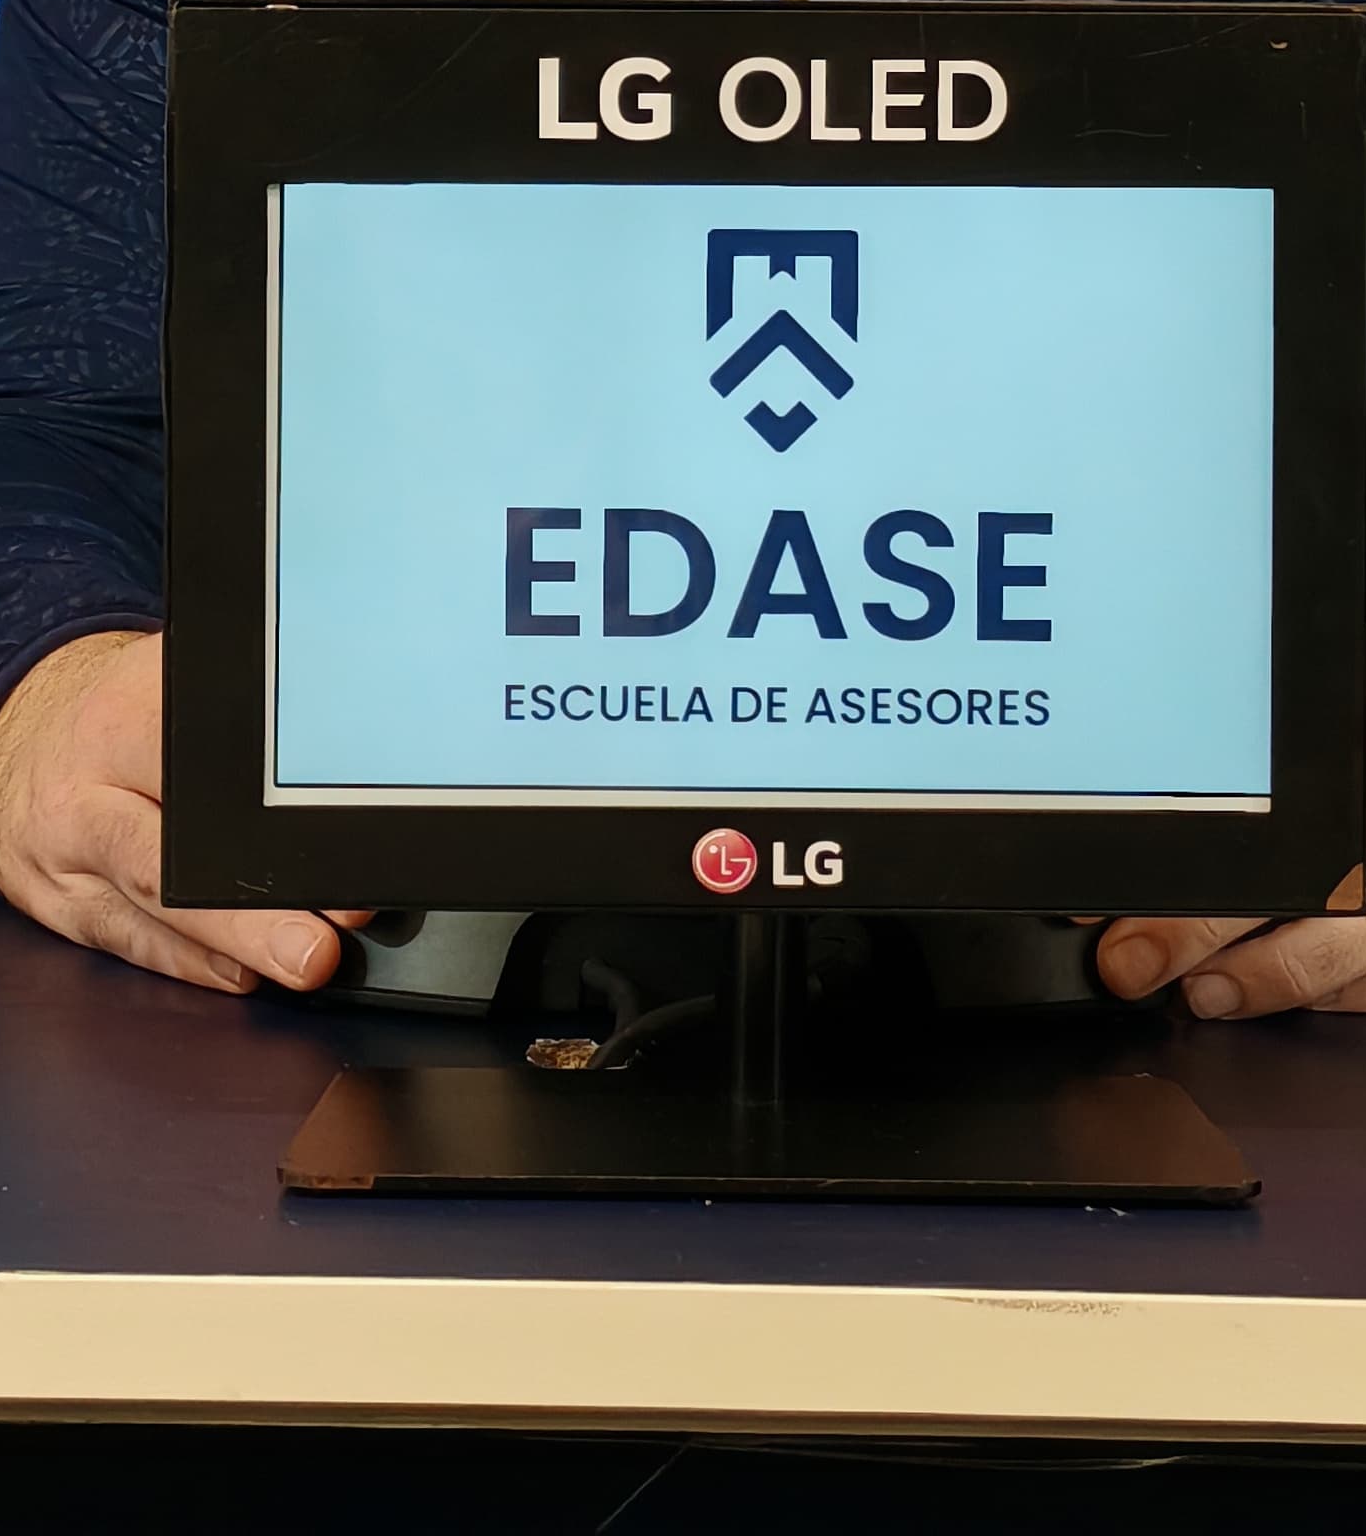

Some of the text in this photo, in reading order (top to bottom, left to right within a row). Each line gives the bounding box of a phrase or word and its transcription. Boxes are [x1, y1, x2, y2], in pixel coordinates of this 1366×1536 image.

[539, 57, 1007, 142] LG OLED
[506, 508, 1053, 641] EDASE
[505, 685, 1049, 725] ESCUELA DE ASESORES
[772, 840, 843, 886] LG
